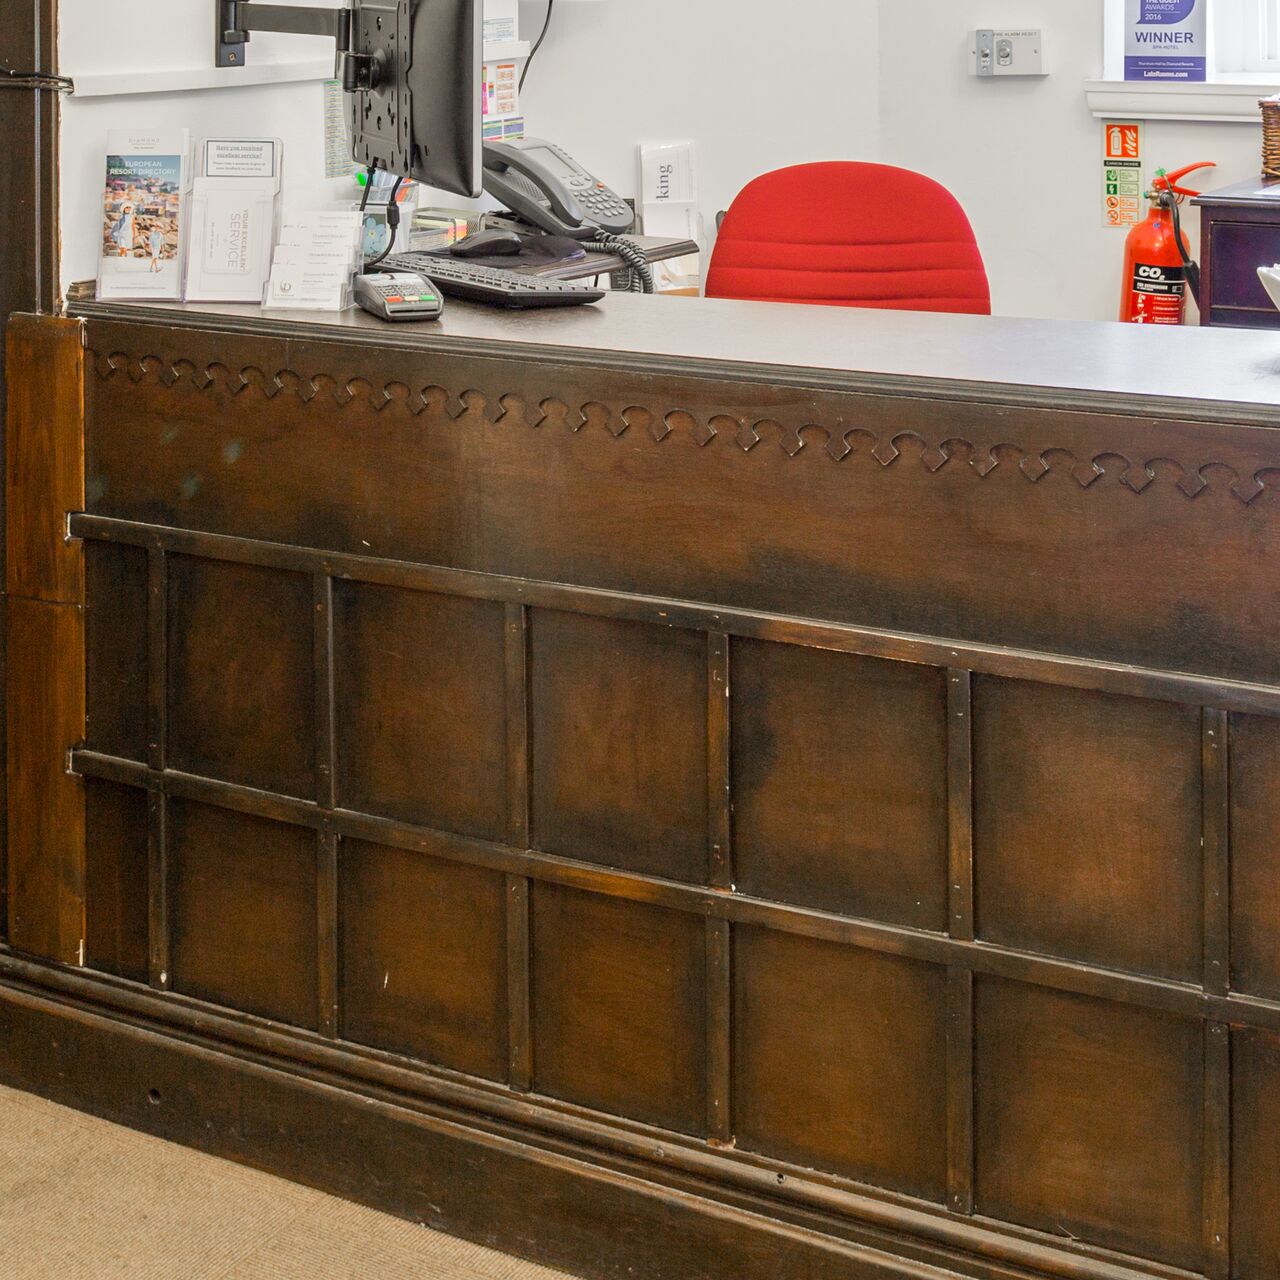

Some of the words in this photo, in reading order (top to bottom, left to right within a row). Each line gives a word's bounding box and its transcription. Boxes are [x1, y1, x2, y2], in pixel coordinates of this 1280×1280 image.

[1135, 32, 1194, 44] WINNER
[1144, 70, 1189, 78] LateRooms.com
[656, 164, 673, 200] king
[228, 213, 241, 268] SERVICE
